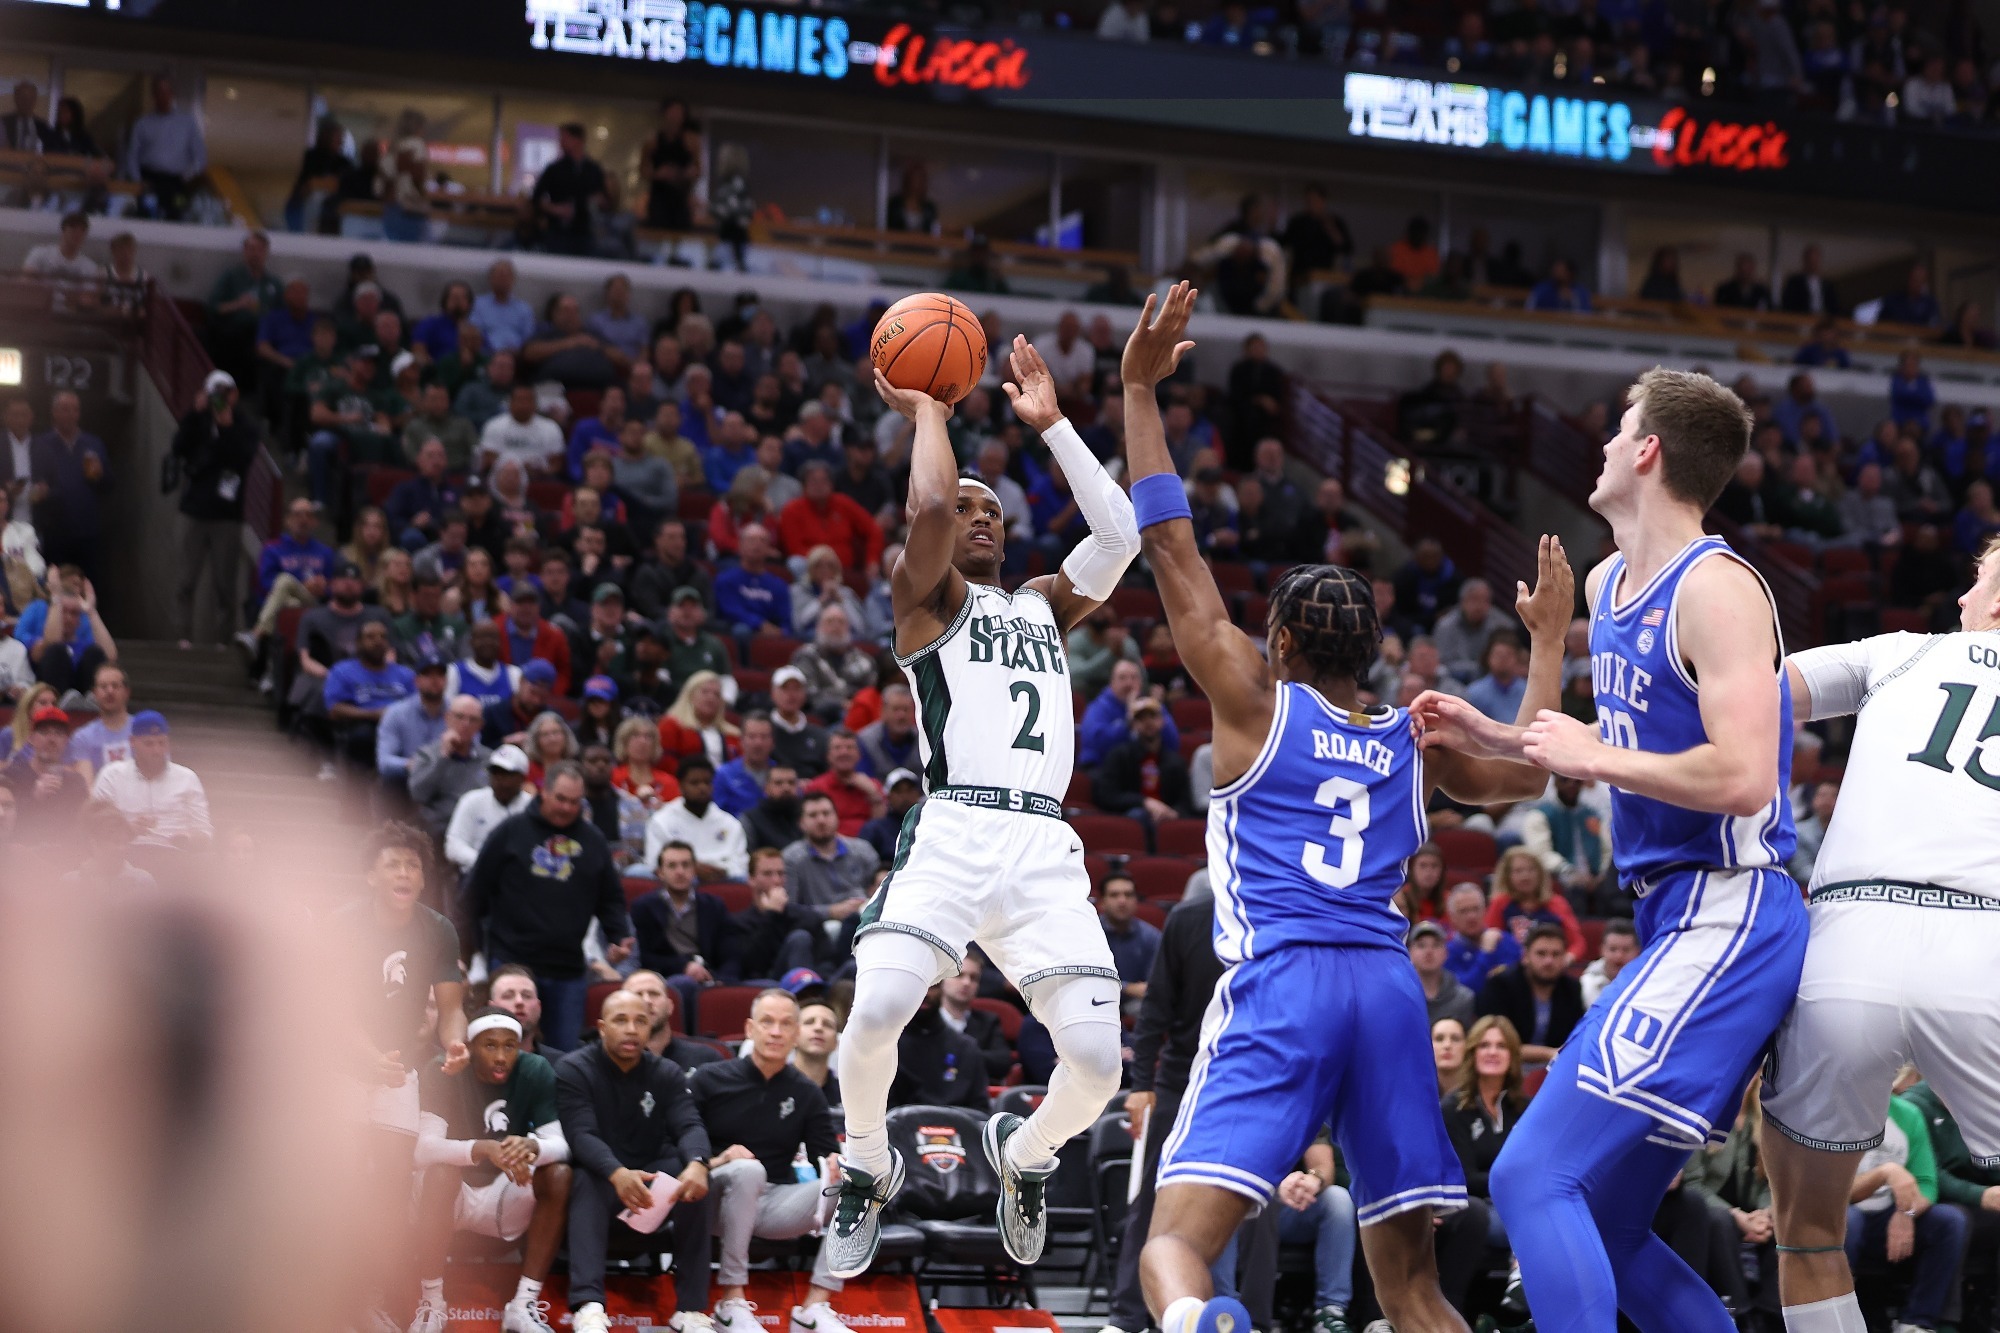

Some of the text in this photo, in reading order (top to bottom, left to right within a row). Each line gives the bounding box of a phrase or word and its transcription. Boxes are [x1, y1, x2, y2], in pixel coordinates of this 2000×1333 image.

[704, 4, 850, 80] GAMES
[1501, 90, 1632, 163] GAMES
[44, 354, 92, 388] 122
[968, 615, 1065, 675] STATE
[1968, 644, 2000, 671] CO
[1591, 652, 1653, 713] DUKE
[1008, 681, 1045, 755] 2
[1907, 682, 2000, 792] 15
[1311, 729, 1395, 777] ROACH
[1008, 789, 1024, 810] S
[1301, 775, 1371, 889] 3
[448, 1307, 503, 1321] StateFa
